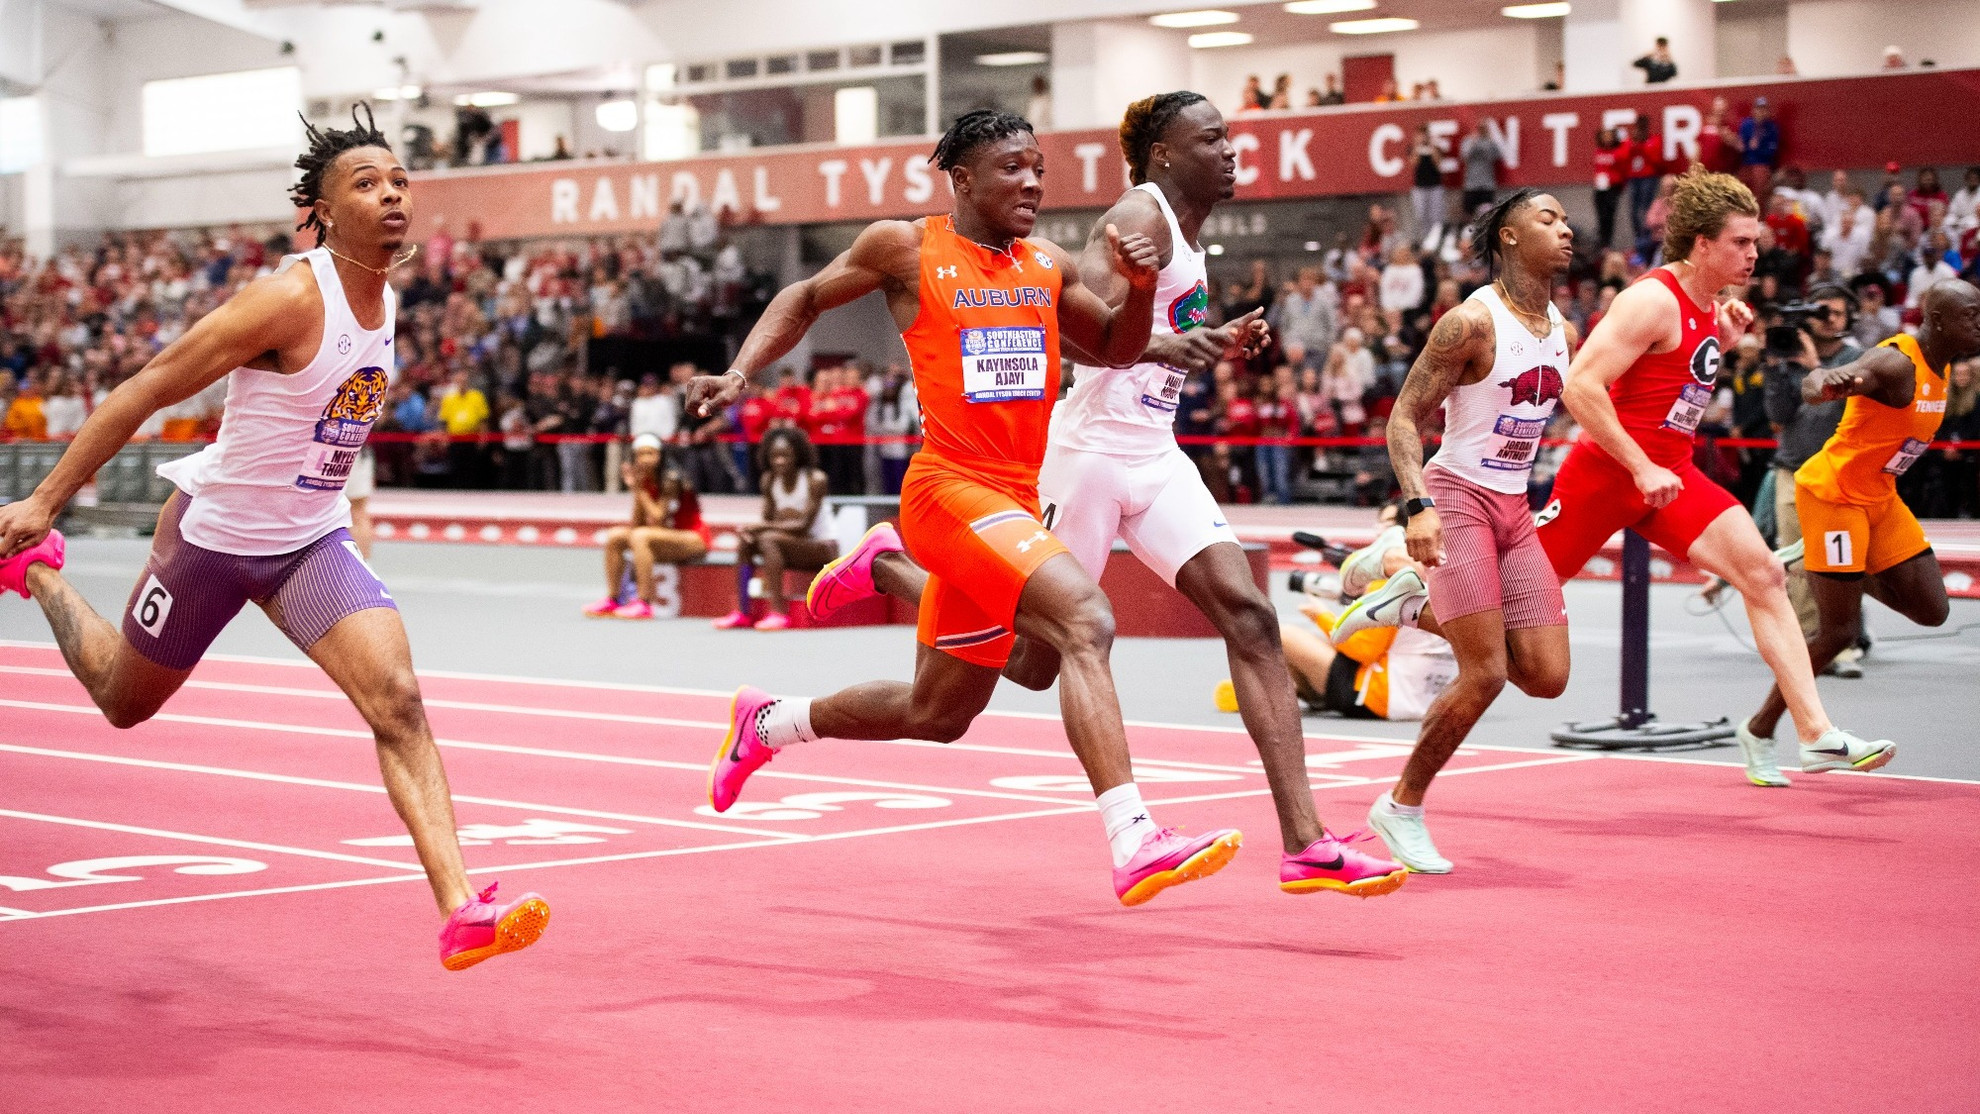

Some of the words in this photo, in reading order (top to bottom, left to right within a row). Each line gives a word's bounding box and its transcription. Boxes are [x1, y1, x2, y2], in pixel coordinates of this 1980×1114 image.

[552, 165, 782, 223] RANDAL
[818, 153, 955, 208] TYS
[1074, 128, 1317, 193] TCK
[953, 287, 1052, 309] AUBURN
[987, 331, 1041, 340] SOUTHEASTERN
[987, 339, 1042, 348] CONFERENCE
[976, 357, 1039, 372] KAYINSOLA
[1689, 336, 1720, 385] G
[995, 372, 1025, 386] AJAYI
[1831, 533, 1844, 563] 1
[140, 586, 167, 628] 6
[693, 791, 954, 821] 3
[0, 854, 268, 892] 5
